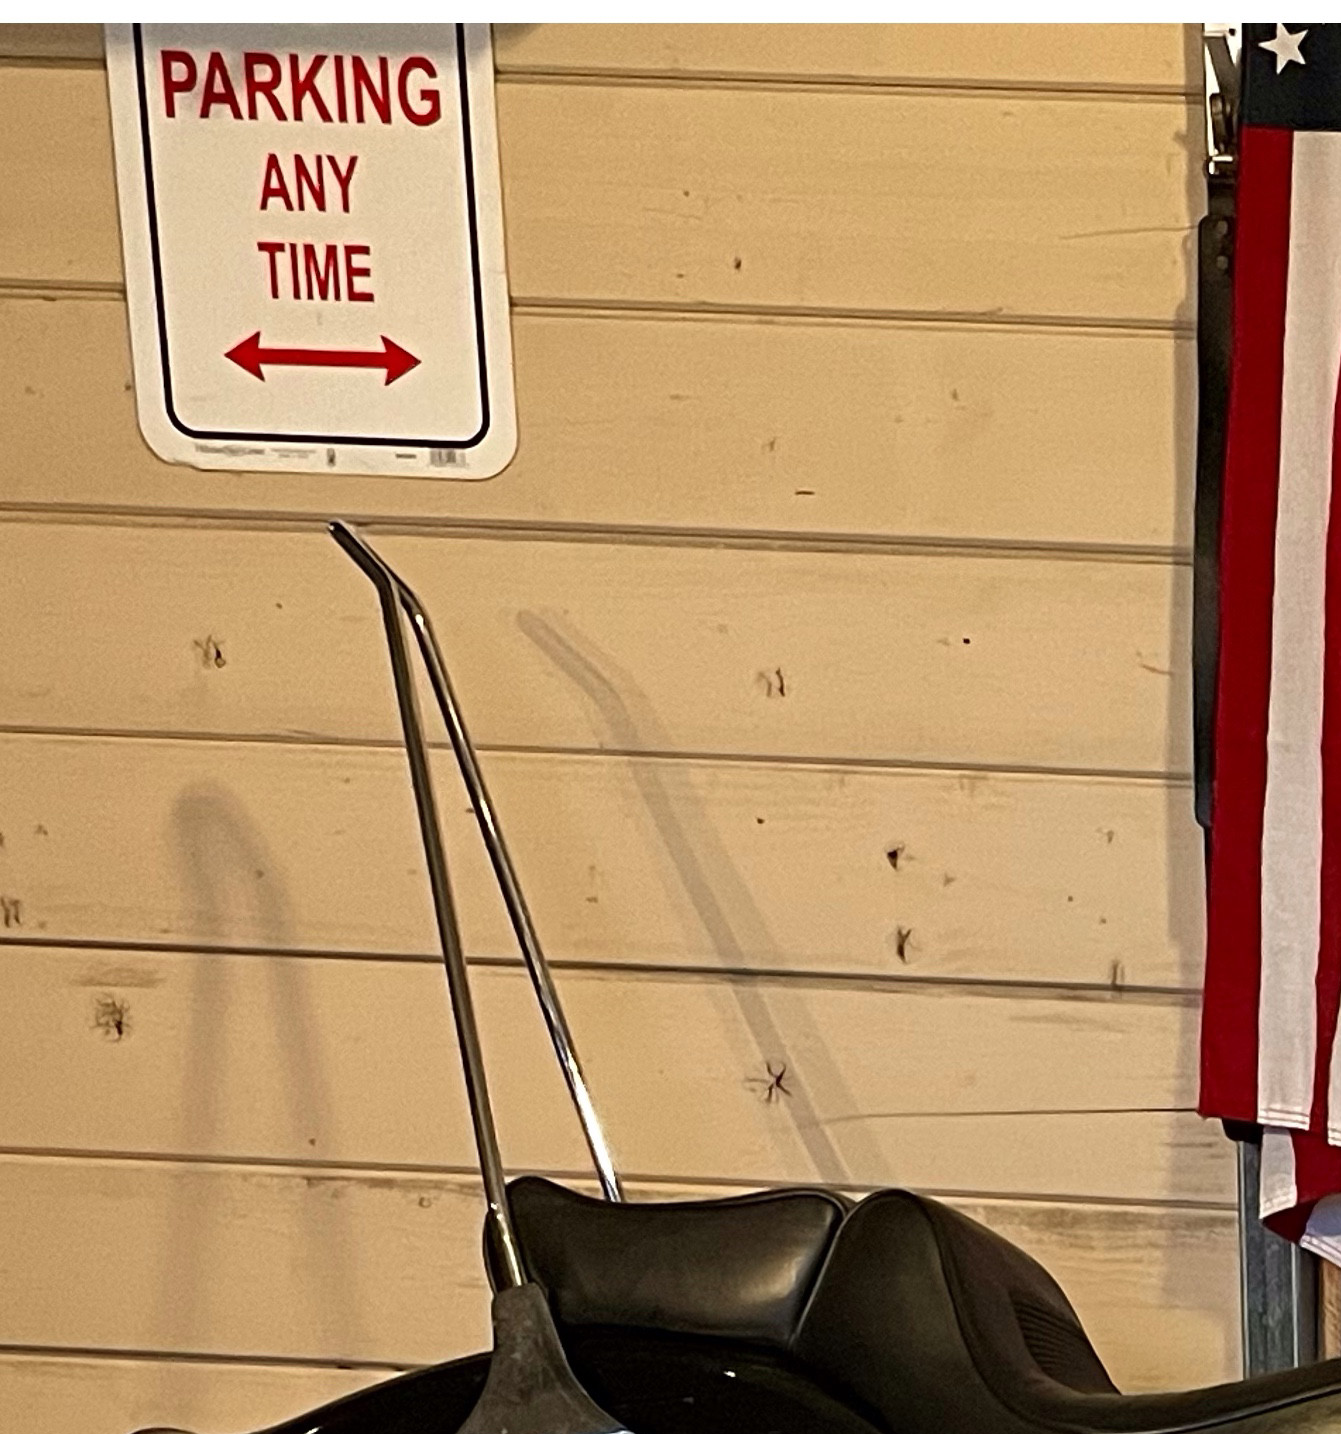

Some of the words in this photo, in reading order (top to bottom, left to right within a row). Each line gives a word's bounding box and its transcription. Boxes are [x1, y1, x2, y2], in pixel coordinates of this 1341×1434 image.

[160, 49, 442, 127] PARKING
[259, 153, 359, 214] ANY
[257, 241, 375, 303] TIME
